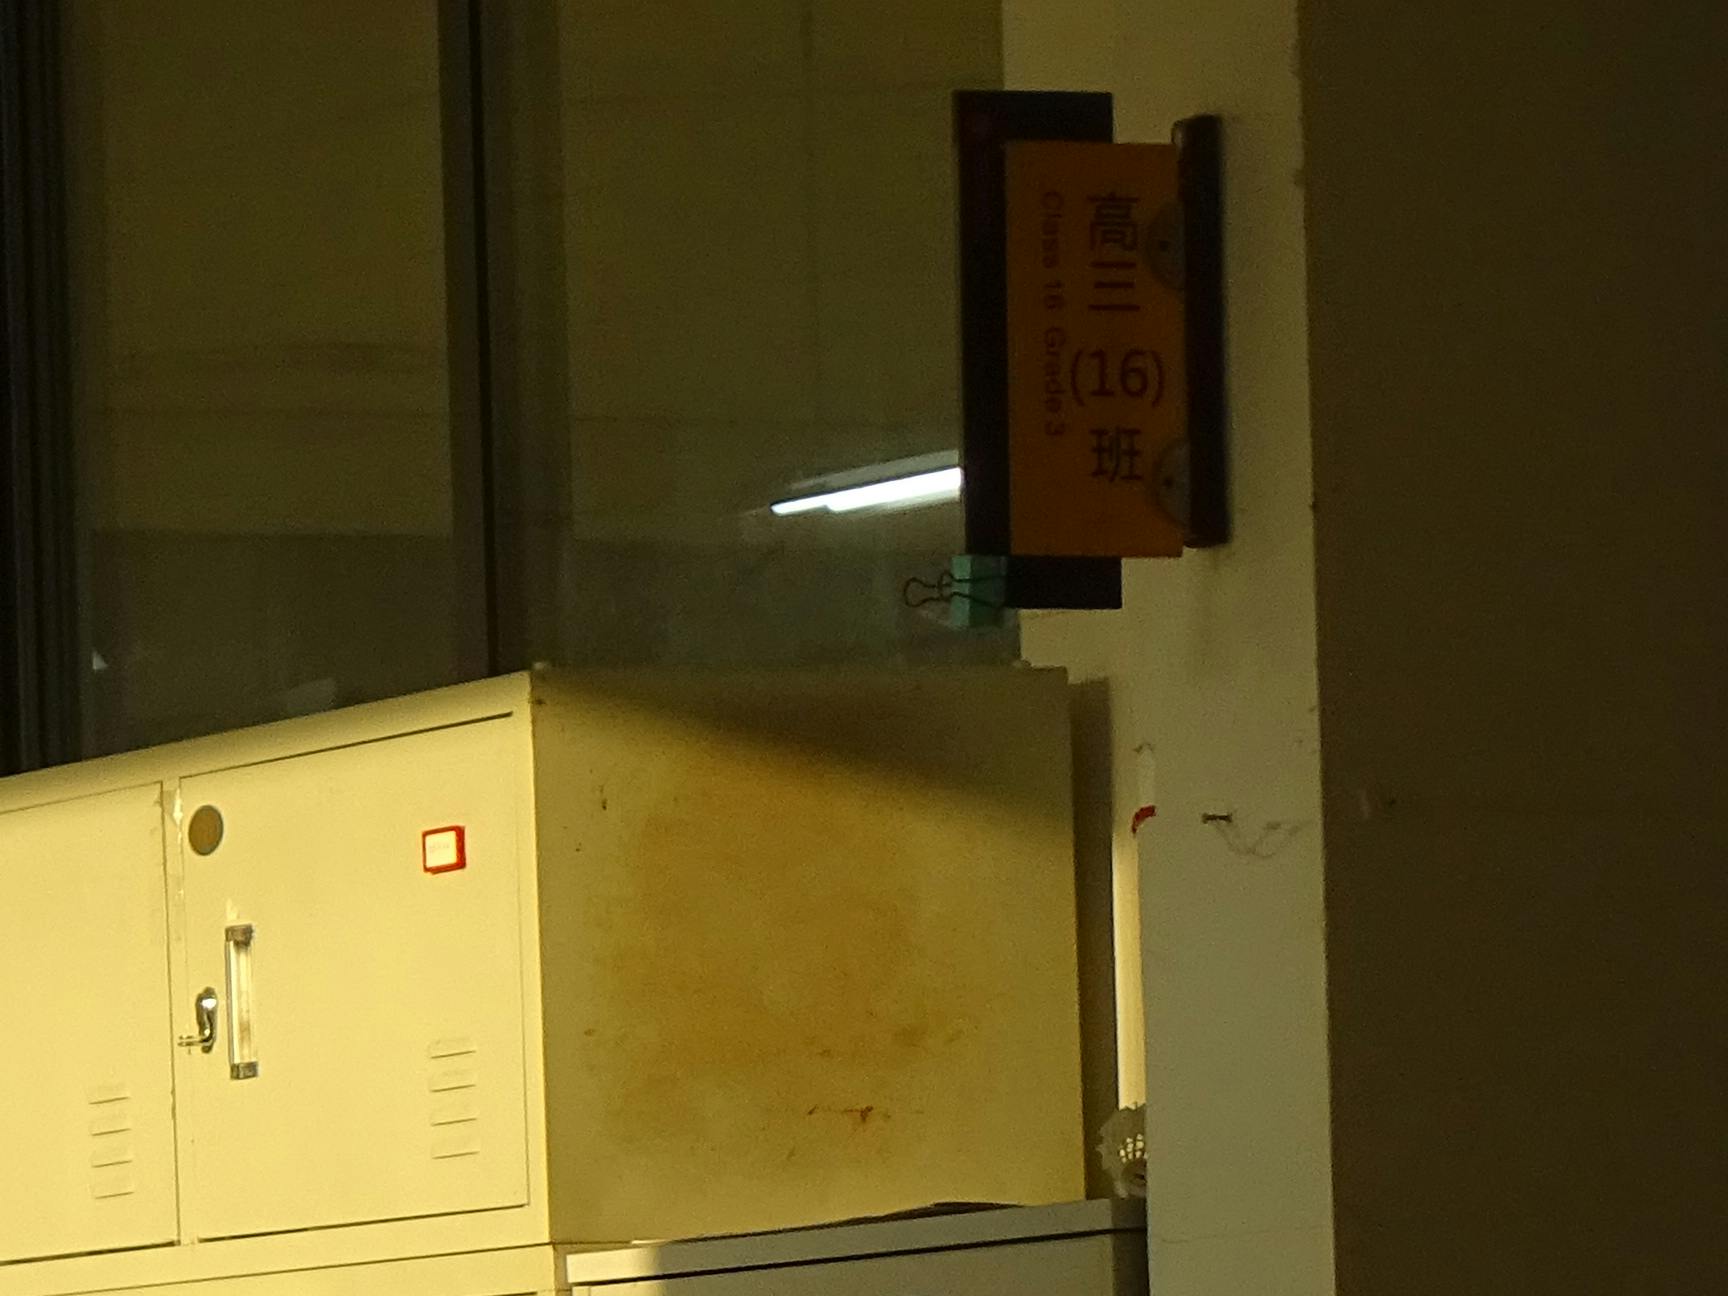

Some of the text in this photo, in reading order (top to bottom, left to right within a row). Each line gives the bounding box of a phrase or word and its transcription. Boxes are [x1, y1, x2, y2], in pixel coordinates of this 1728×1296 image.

[1039, 190, 1066, 269] Class
[1070, 191, 1166, 483] 高三(16)班
